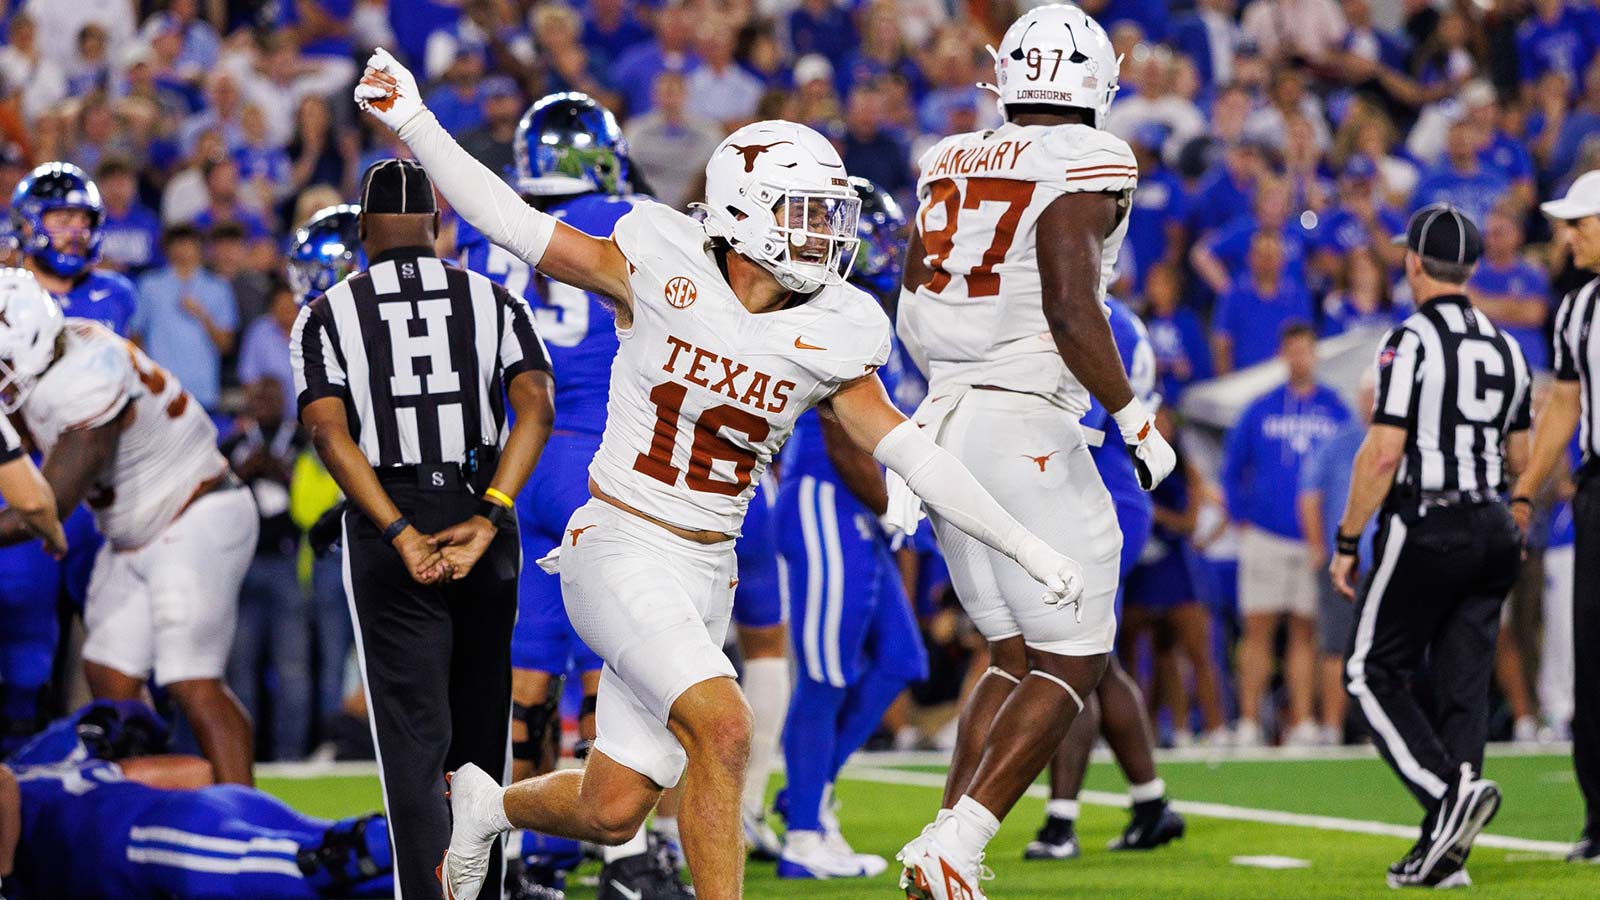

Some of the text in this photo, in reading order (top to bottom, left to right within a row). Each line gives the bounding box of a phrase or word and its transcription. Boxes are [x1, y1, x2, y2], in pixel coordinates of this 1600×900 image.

[1017, 90, 1073, 102] LONGHORNS
[1026, 47, 1063, 82] 97
[928, 141, 1032, 176] JANUARY
[921, 177, 1036, 298] 97
[666, 278, 697, 308] SEC
[378, 298, 461, 396] H
[662, 335, 797, 414] TEXAS
[1457, 338, 1505, 422] C
[632, 381, 771, 497] 16
